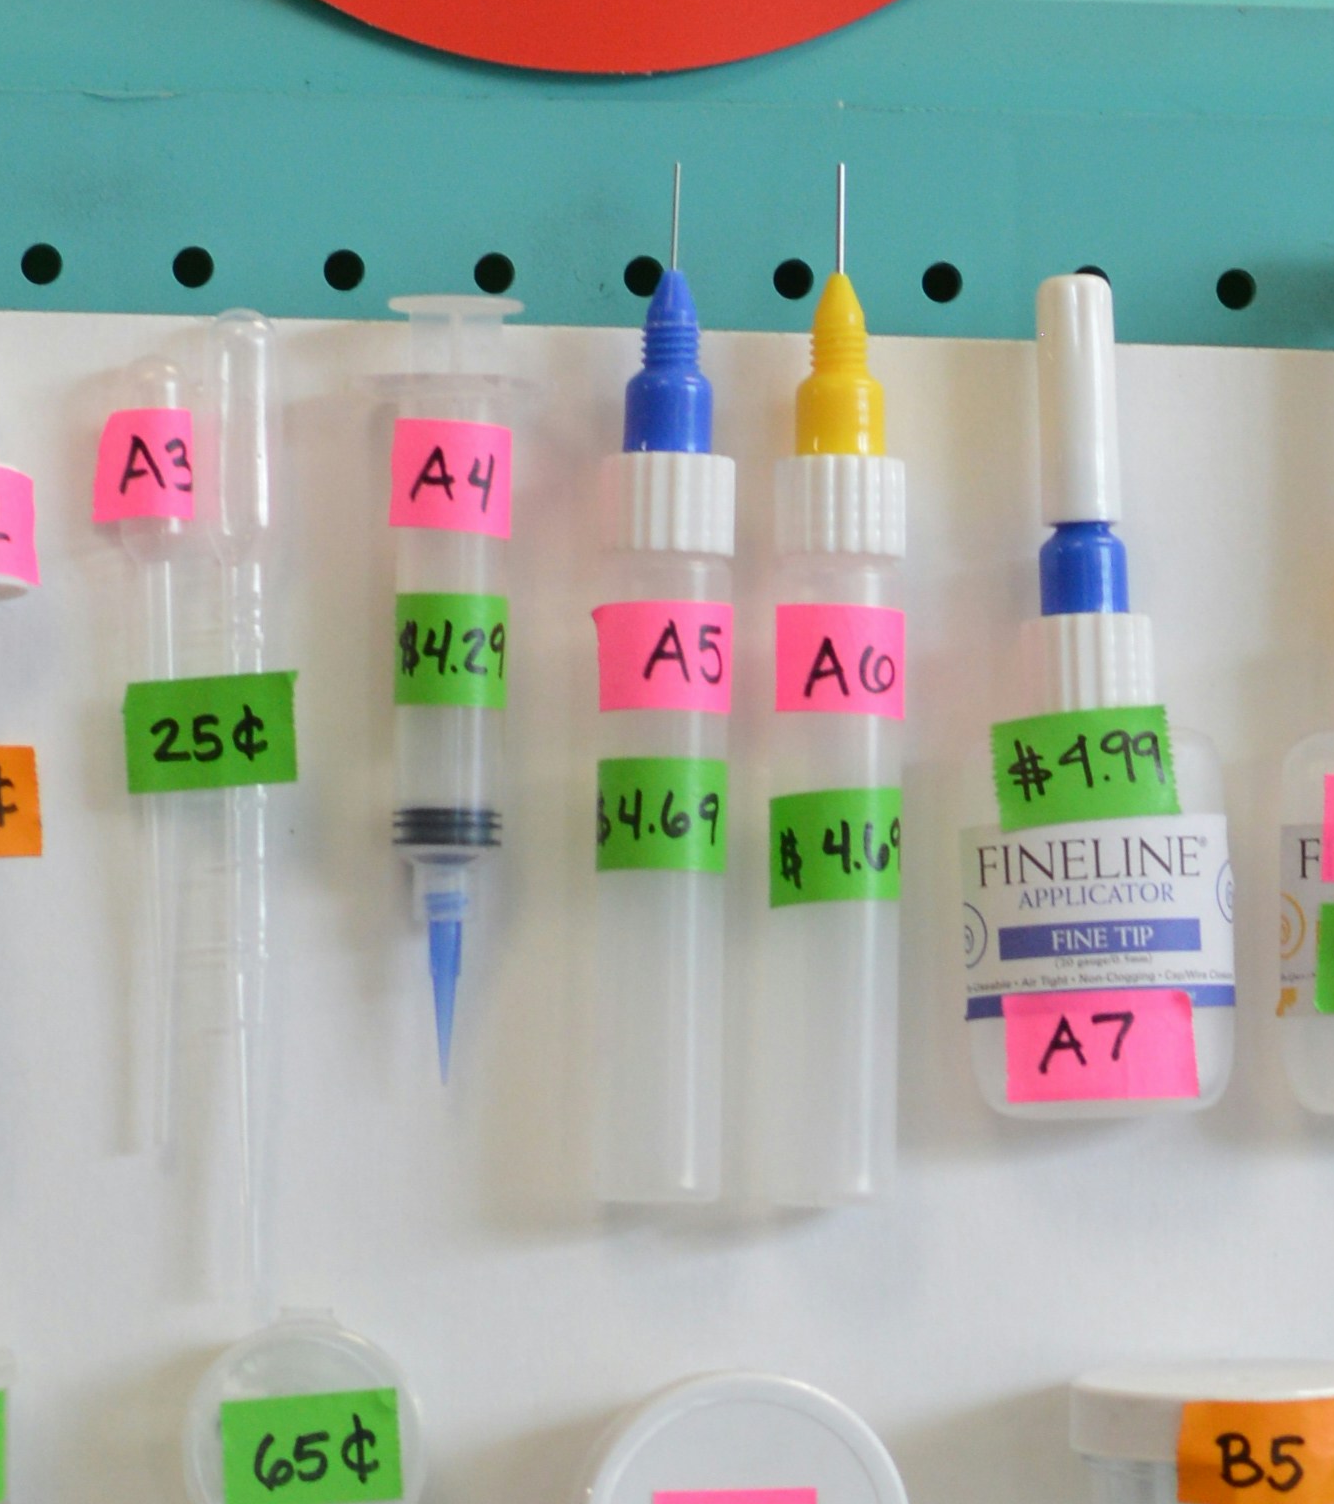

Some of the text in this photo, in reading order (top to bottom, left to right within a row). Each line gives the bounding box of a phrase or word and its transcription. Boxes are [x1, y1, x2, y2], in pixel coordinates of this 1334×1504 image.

[119, 433, 193, 495] A3
[410, 446, 495, 513] A4
[399, 619, 506, 681] $4.29
[643, 618, 724, 685] A5
[804, 636, 897, 699] A6
[152, 703, 268, 765] 25¢
[1007, 729, 1166, 803] $4.99
[597, 787, 720, 847] $4.69
[1018, 882, 1176, 910] APPLICATOR
[1051, 924, 1154, 951] FINE TIP
[1039, 1011, 1134, 1075] A7
[251, 1414, 380, 1494] 65¢
[1214, 1431, 1305, 1493] B5
